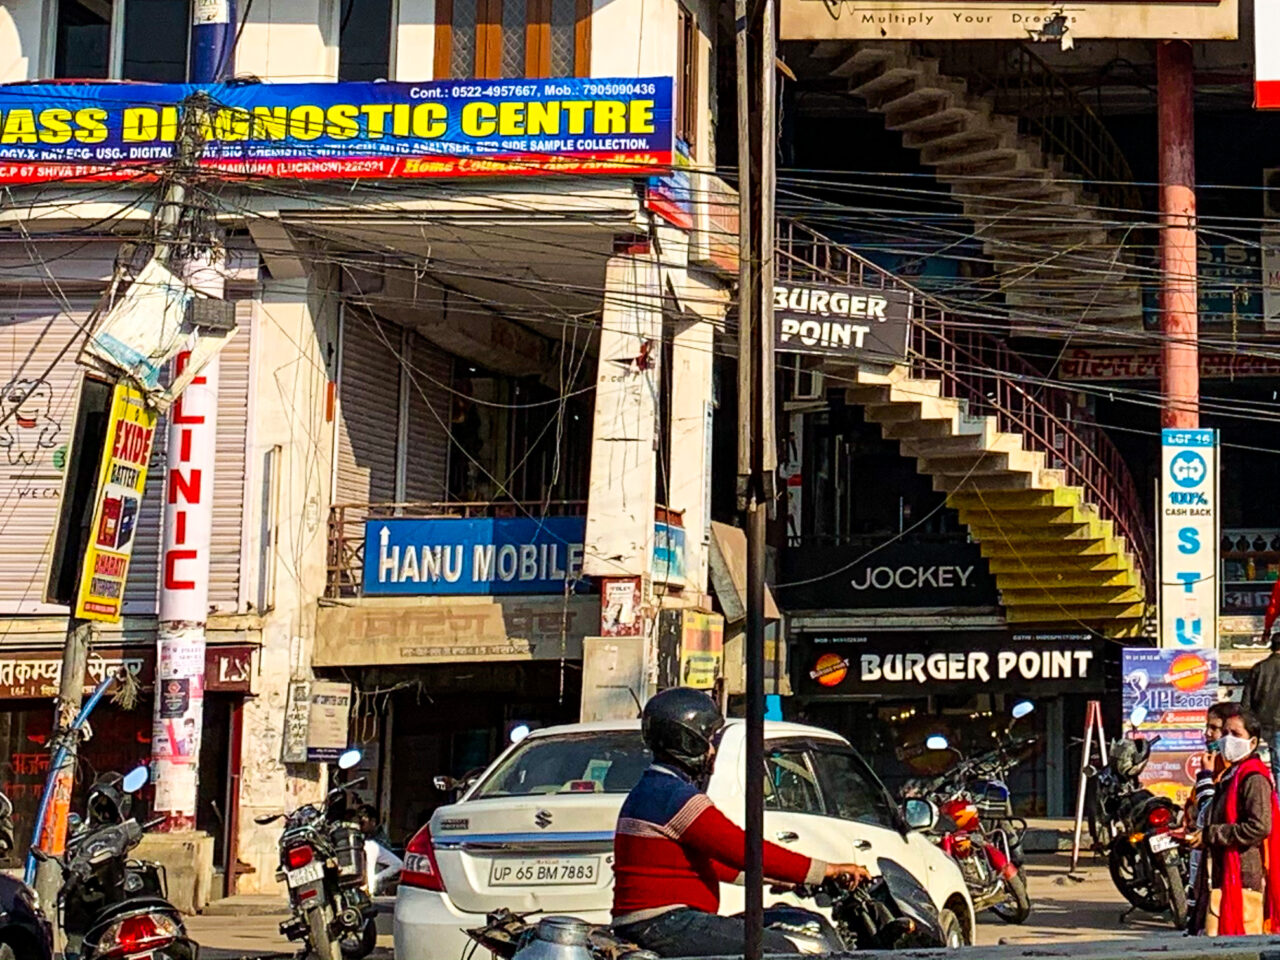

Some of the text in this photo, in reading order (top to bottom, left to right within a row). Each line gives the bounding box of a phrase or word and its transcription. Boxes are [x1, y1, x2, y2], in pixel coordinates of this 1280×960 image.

[862, 13, 992, 25] Multiply Your
[452, 86, 540, 99] 0522-4957667,
[461, 100, 655, 137] CENTRE
[578, 138, 649, 151] COLLECTION.
[772, 286, 887, 322] BURGER
[781, 318, 870, 348] POINT
[113, 418, 155, 465] EXIDE
[1168, 491, 1208, 505] 100%
[379, 542, 583, 583] HANU MOBILE
[852, 566, 974, 590] JOCKEY
[861, 650, 1093, 683] BURGER POINT
[1149, 689, 1211, 709] IPL 2020
[494, 867, 512, 881] UP
[515, 866, 534, 880] 65
